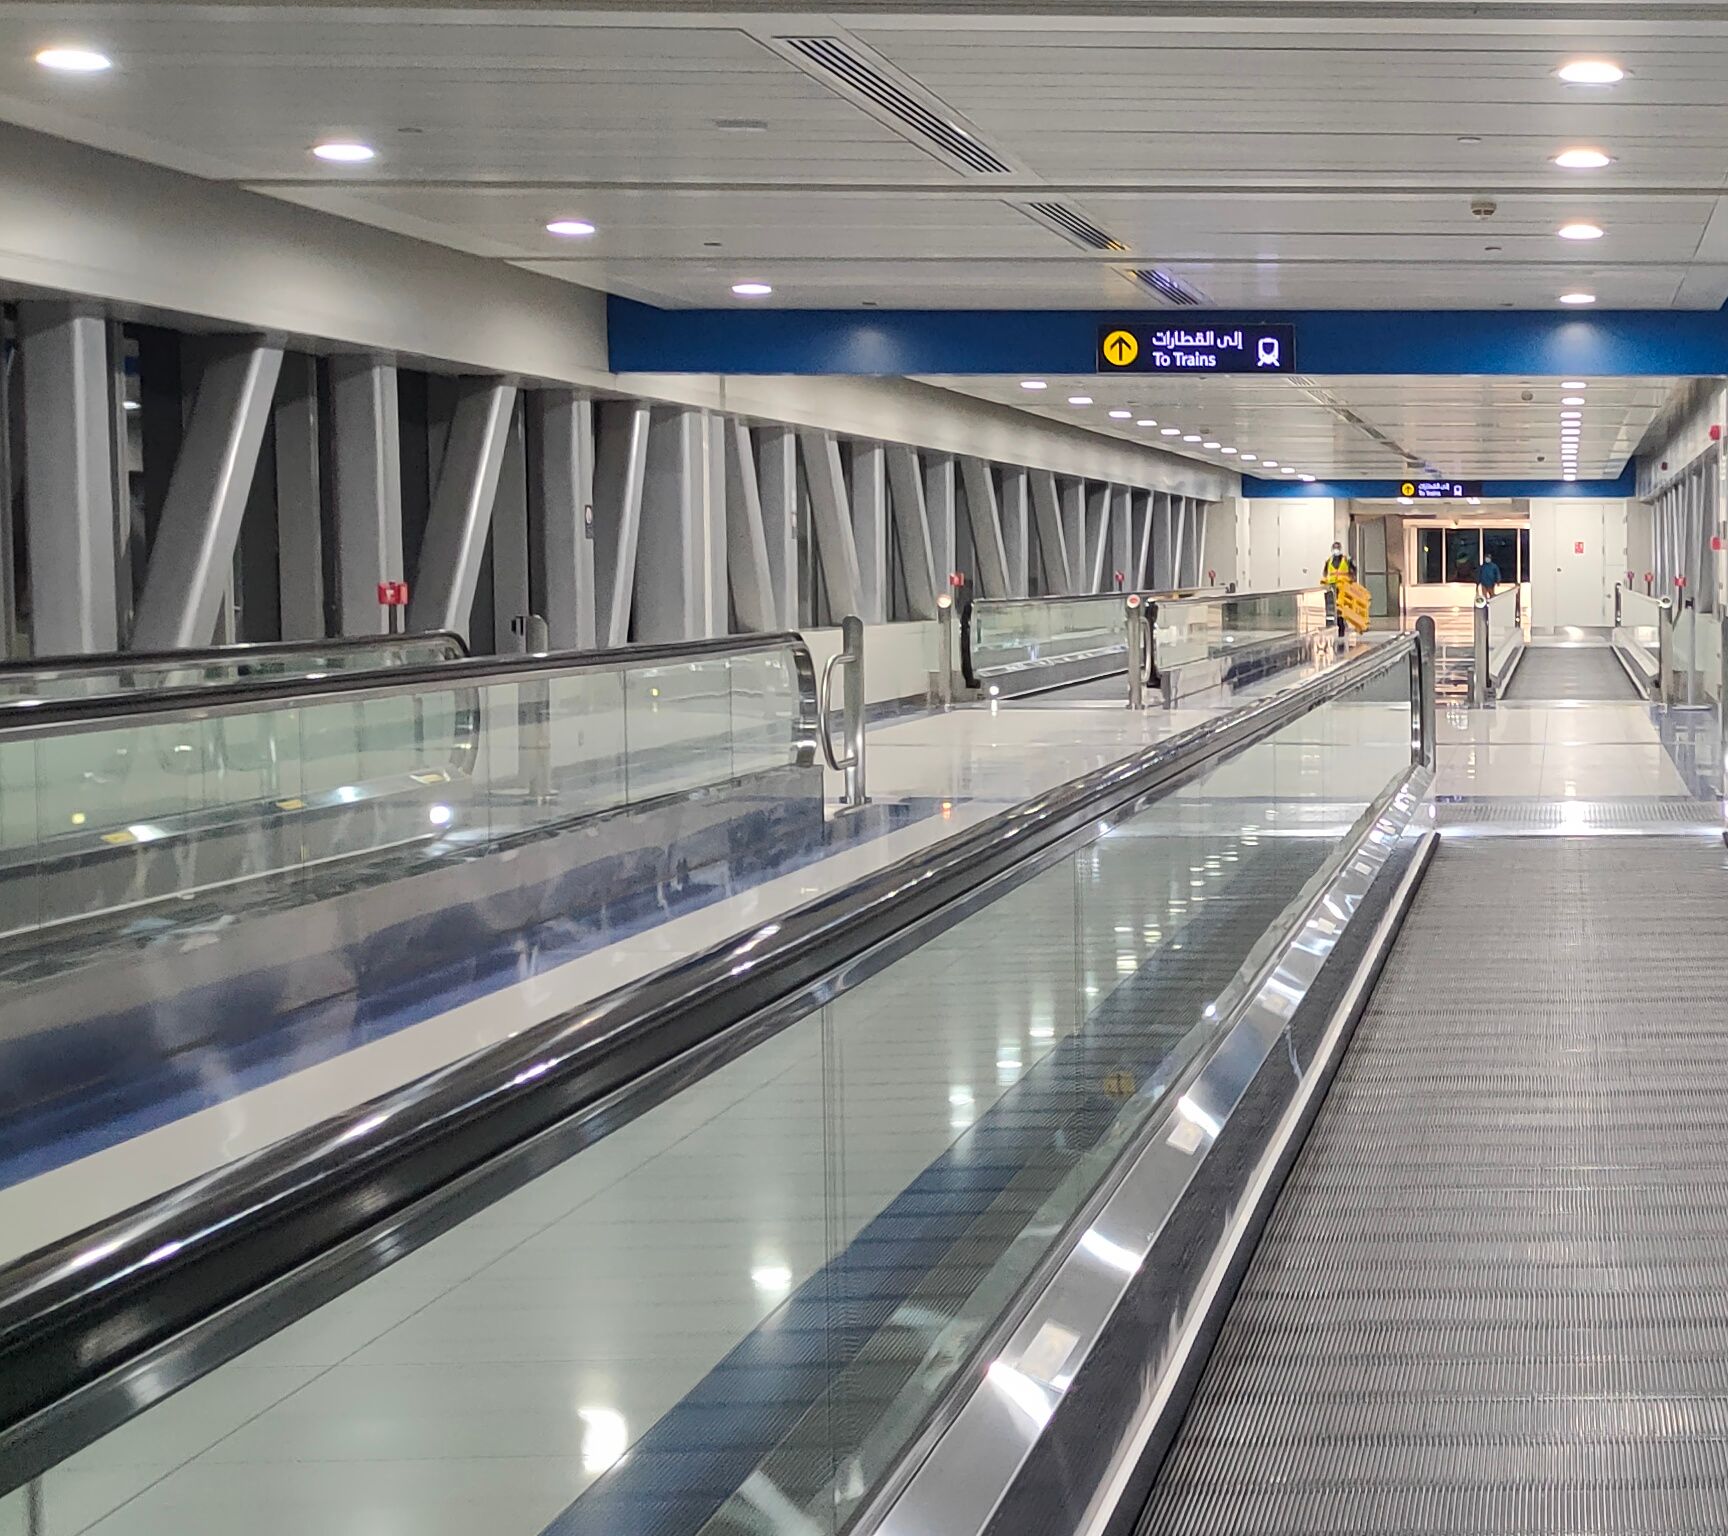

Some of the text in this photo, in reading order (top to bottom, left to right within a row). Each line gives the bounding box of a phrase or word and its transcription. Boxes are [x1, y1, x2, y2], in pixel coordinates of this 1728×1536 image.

[1152, 330, 1243, 350] إلى القطارات
[1152, 351, 1216, 367] To Trains
